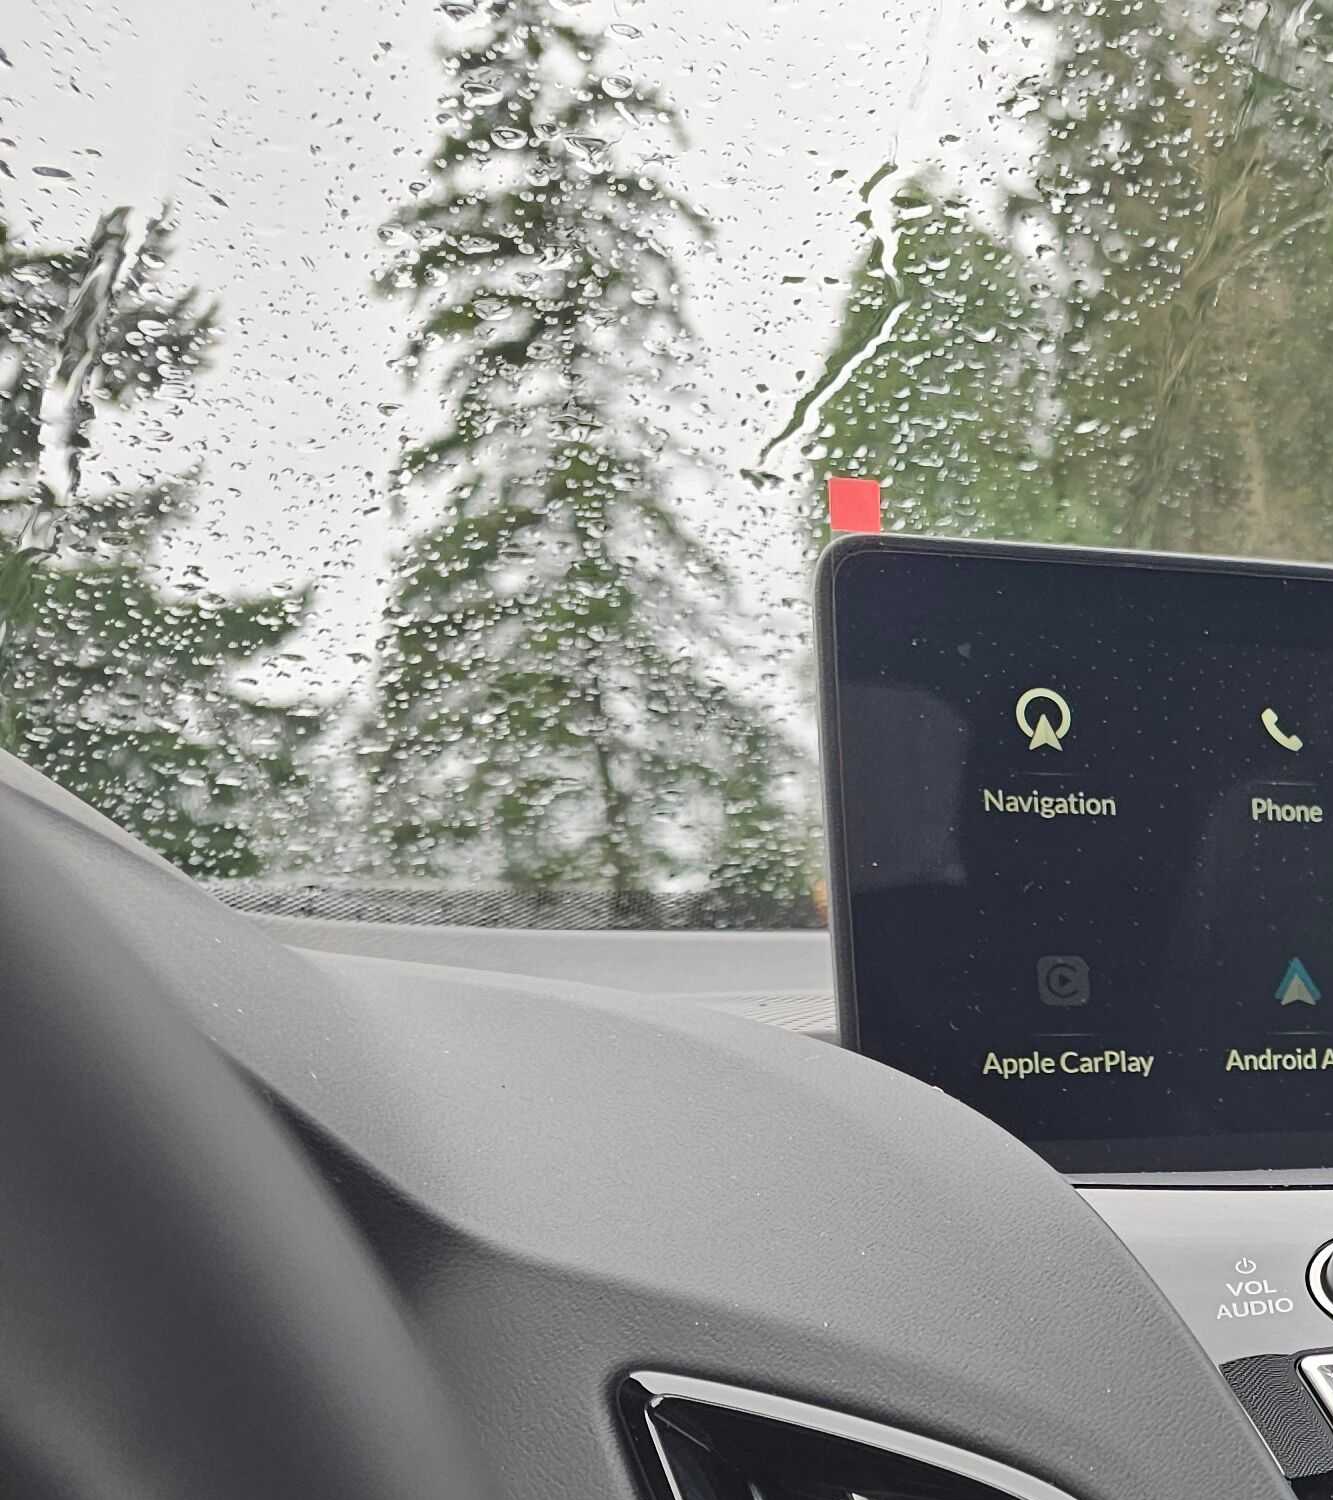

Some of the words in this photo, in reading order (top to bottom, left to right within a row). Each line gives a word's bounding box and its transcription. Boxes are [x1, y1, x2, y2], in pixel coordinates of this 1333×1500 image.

[983, 790, 1117, 818] Navigation
[1251, 797, 1323, 823] Phone
[982, 1051, 1055, 1079] Apple
[1060, 1050, 1154, 1077] CarPlay
[1226, 1049, 1317, 1072] Android
[1226, 1278, 1278, 1297] VOL
[1216, 1297, 1294, 1321] AUDIO
